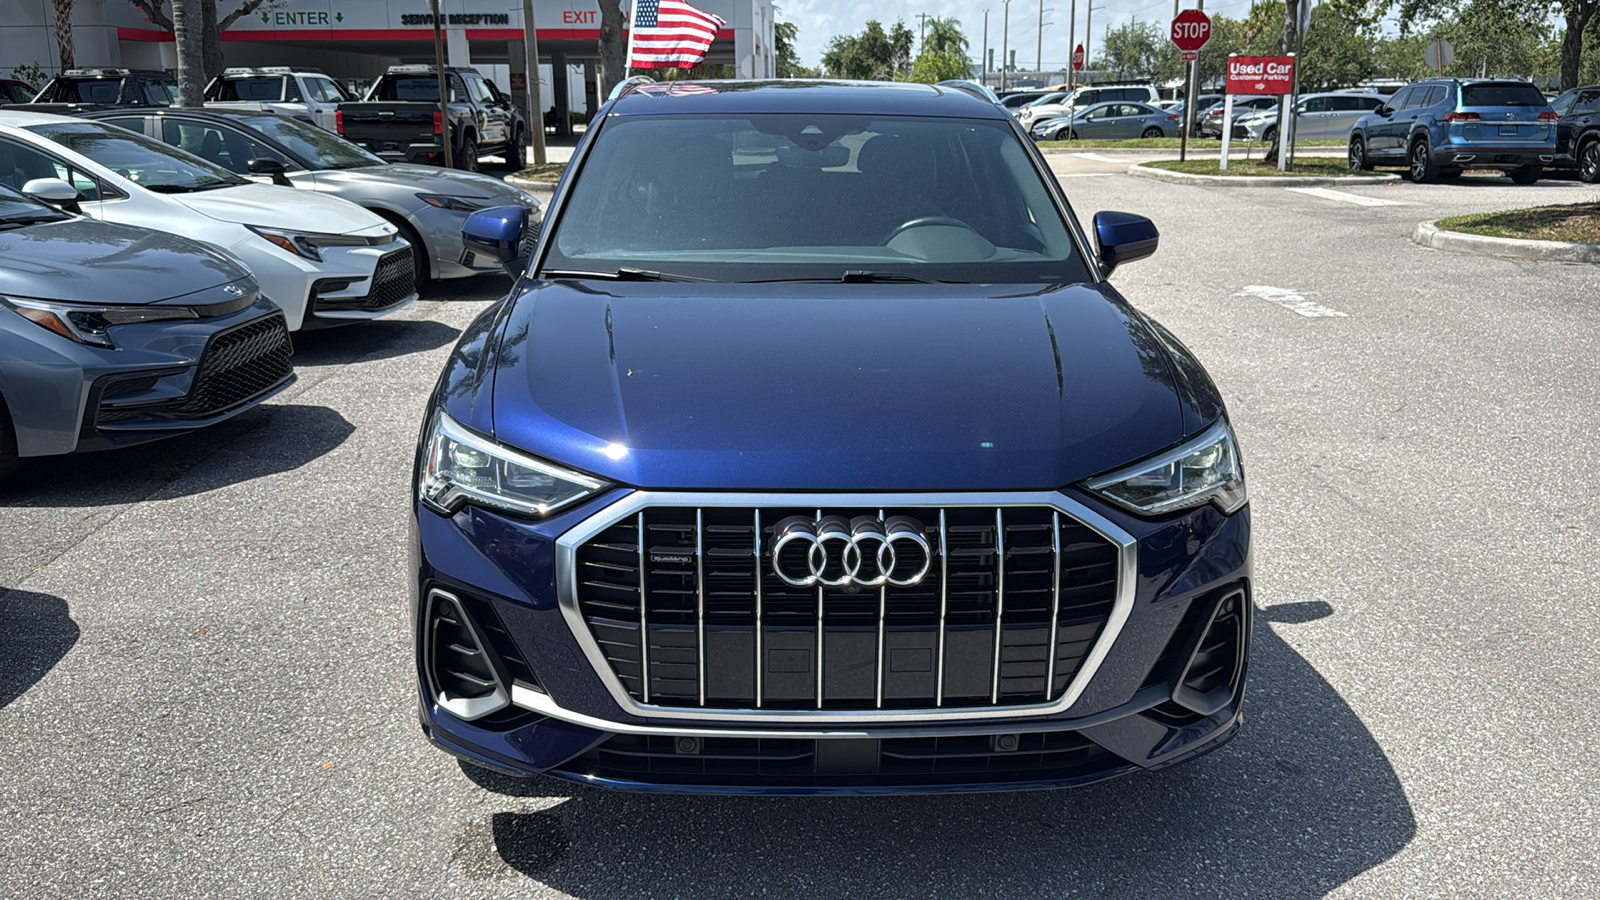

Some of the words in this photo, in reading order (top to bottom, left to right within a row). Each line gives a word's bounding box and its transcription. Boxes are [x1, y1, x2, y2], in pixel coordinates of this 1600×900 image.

[275, 11, 330, 25] ENTER
[400, 13, 447, 25] SERVIE
[448, 13, 509, 25] RECEPTION
[562, 11, 597, 24] EXIT
[1173, 22, 1209, 39] STOP
[1073, 52, 1084, 63] STOP
[1230, 62, 1264, 74] Used
[1266, 62, 1292, 74] Car
[1263, 74, 1290, 82] Parking
